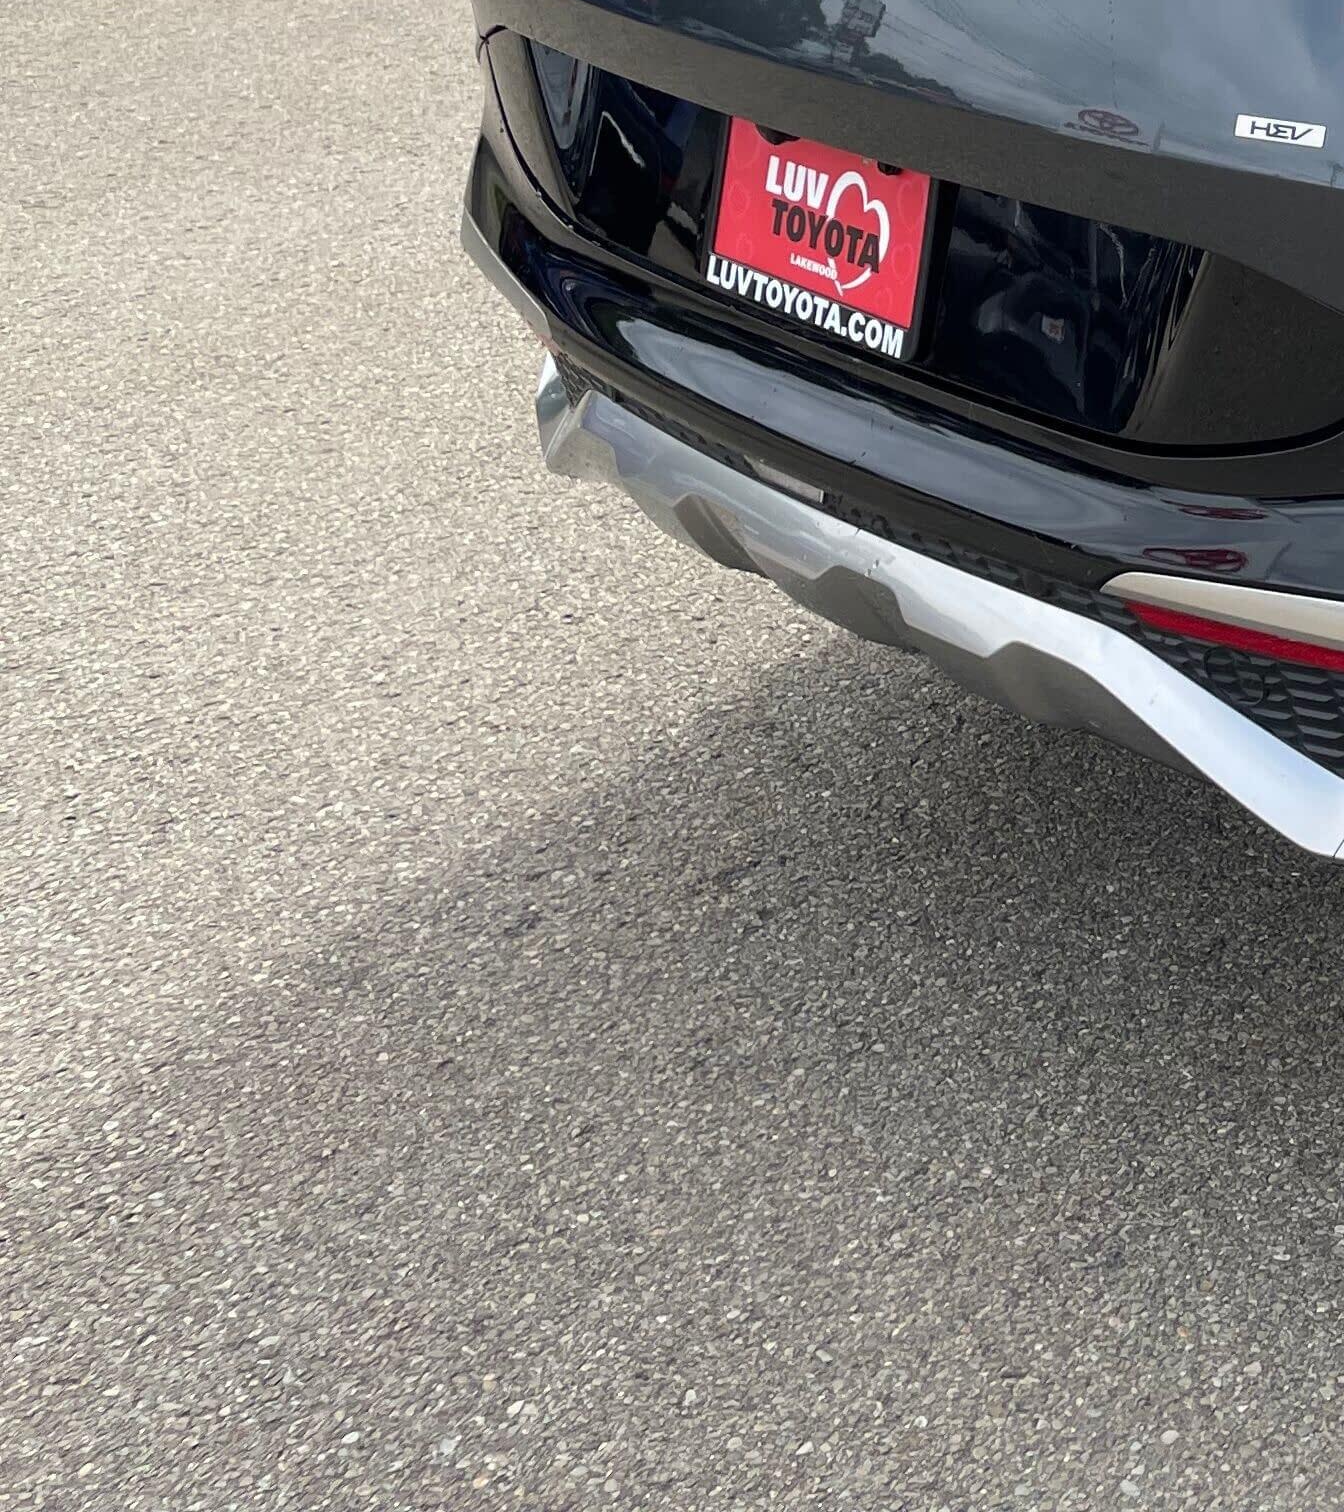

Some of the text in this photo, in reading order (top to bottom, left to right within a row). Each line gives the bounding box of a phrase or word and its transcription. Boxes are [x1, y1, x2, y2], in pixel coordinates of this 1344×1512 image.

[1250, 121, 1314, 140] HEV
[765, 155, 829, 210] LUV
[771, 199, 881, 274] TOYOTA
[790, 253, 838, 281] LAKEWOOD
[706, 254, 904, 359] LUVTOYOTA.COM
